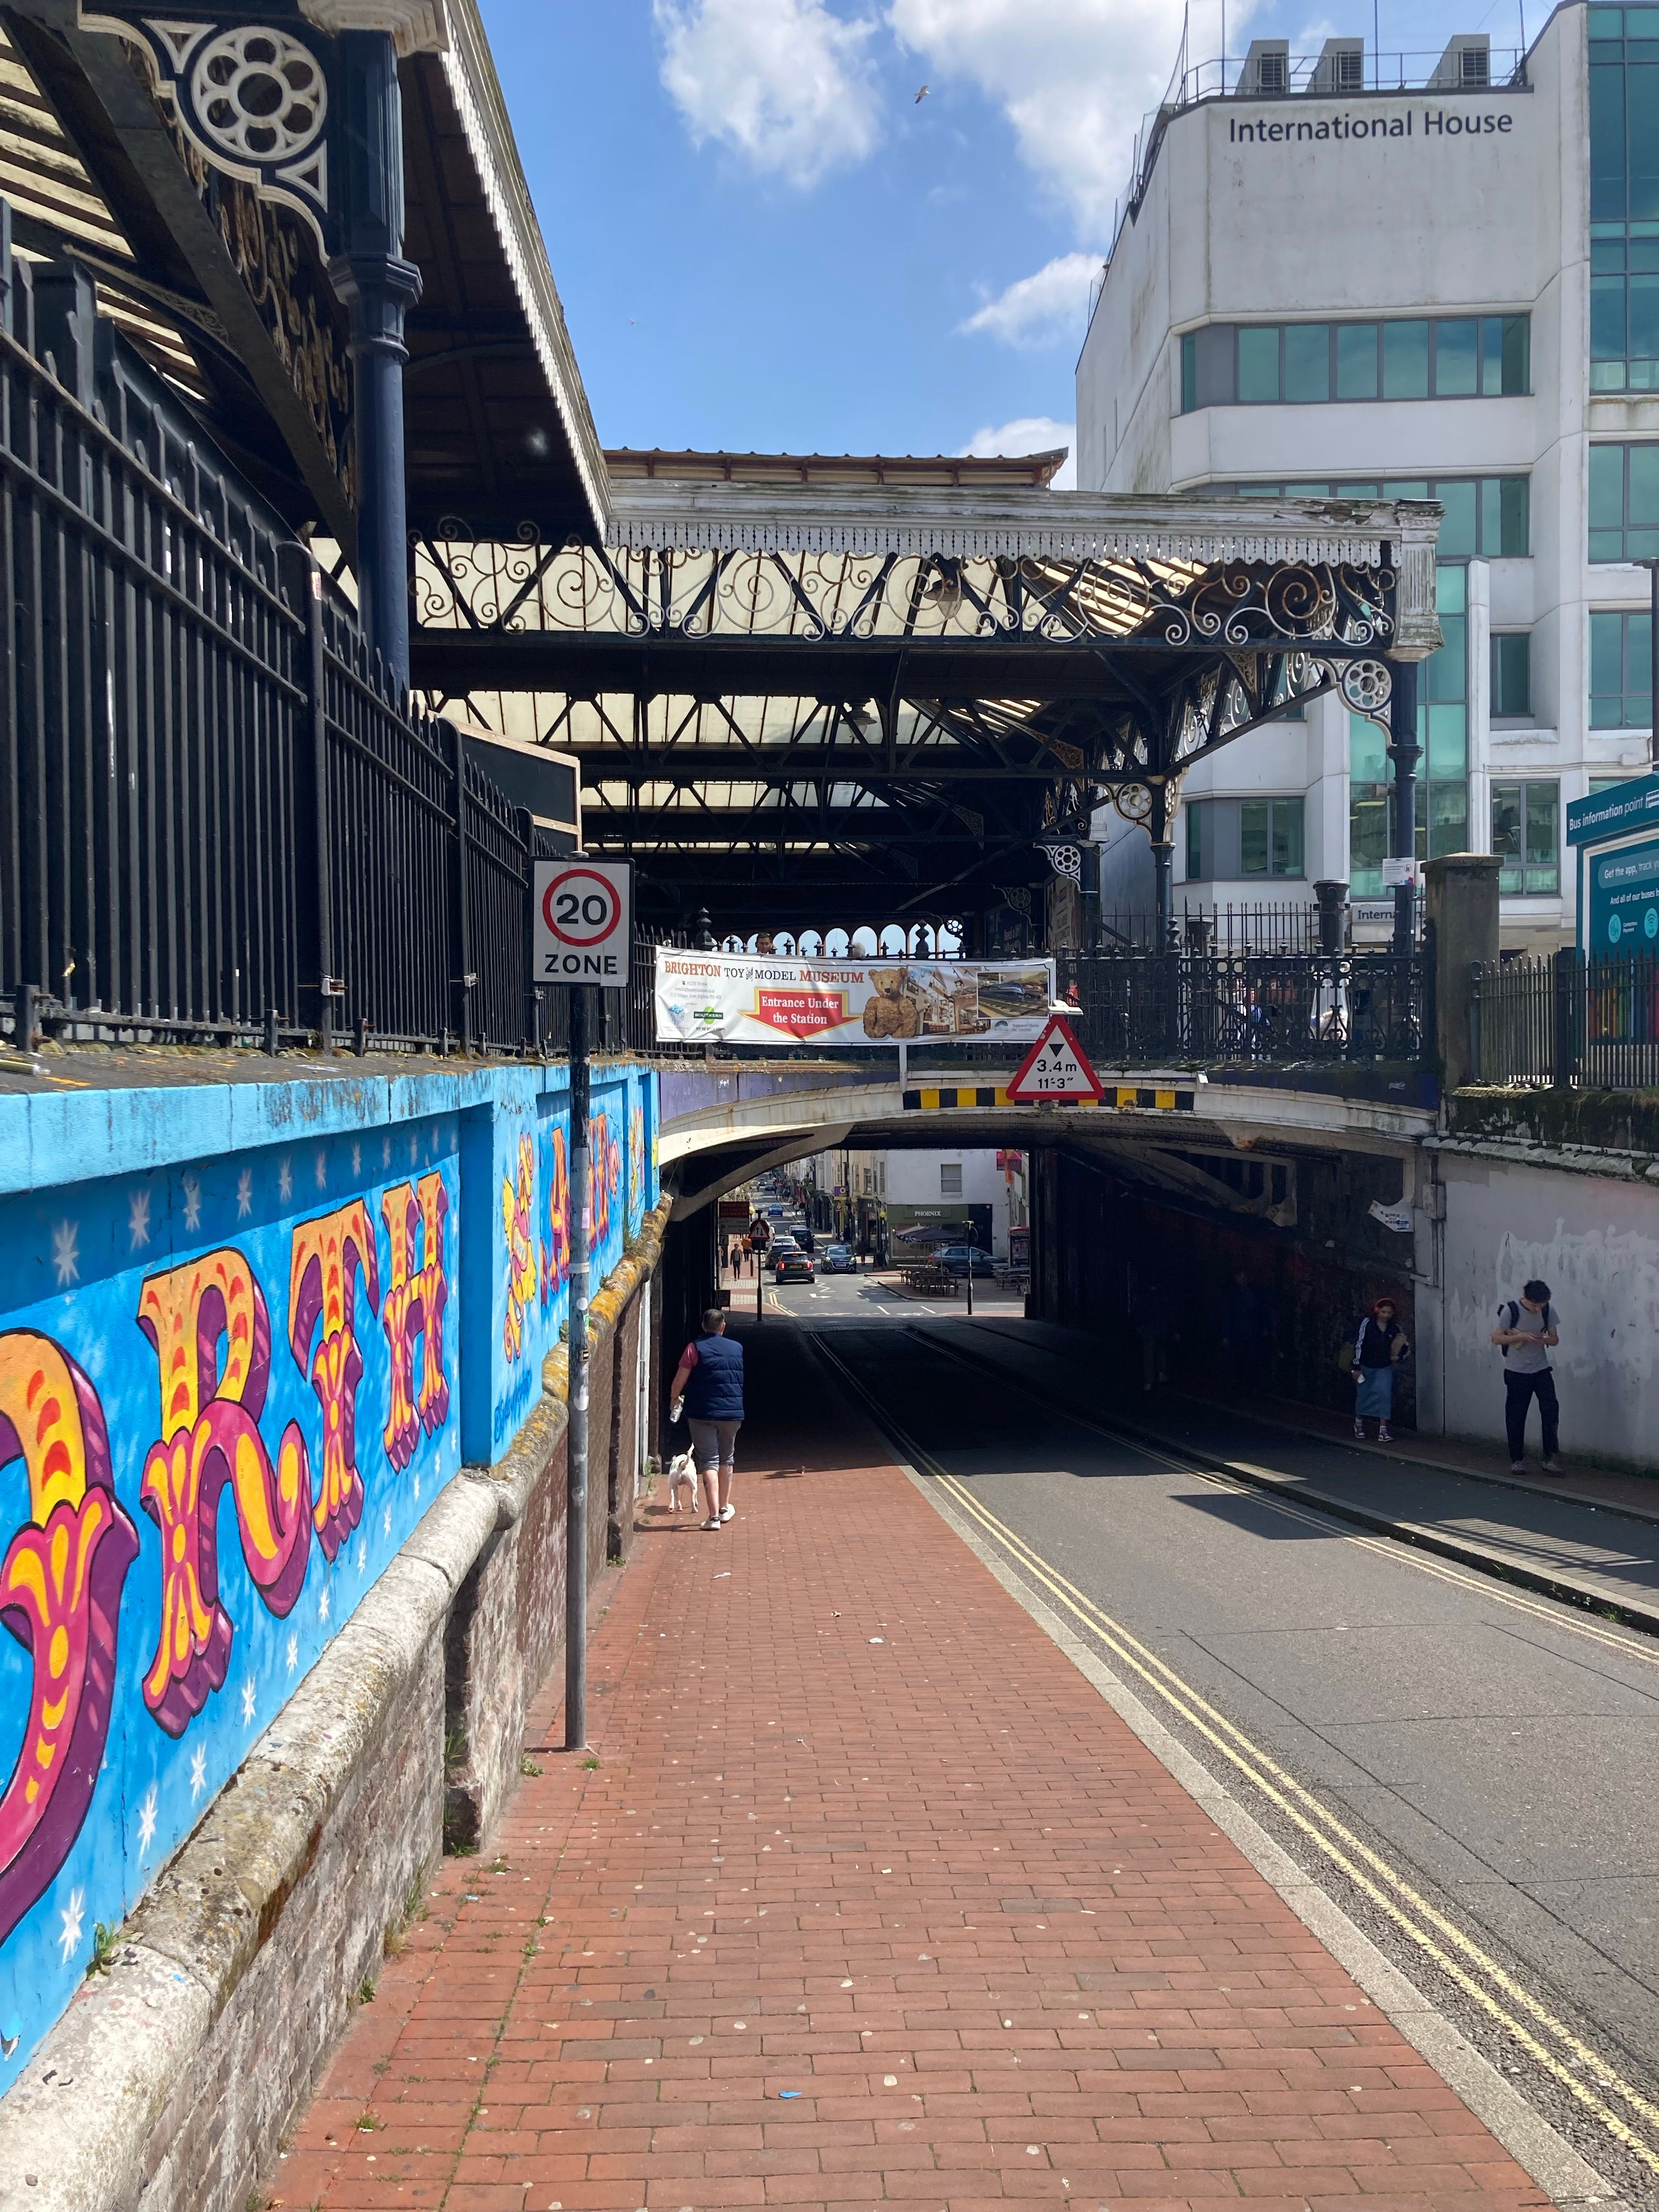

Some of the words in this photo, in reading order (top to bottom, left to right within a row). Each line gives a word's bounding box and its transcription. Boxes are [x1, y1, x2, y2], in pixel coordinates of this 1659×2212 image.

[1231, 110, 1412, 142] International
[1425, 111, 1513, 135] House
[1569, 819, 1581, 831] Bus
[1583, 804, 1623, 827] information
[1624, 796, 1644, 817] point
[1604, 868, 1615, 879] Get
[1615, 867, 1624, 877] the
[1626, 865, 1638, 877] app,
[1610, 895, 1620, 905] And
[1626, 893, 1632, 901] of
[1641, 890, 1655, 899] buses
[556, 894, 607, 926] 20
[545, 954, 617, 974] ZONE
[665, 961, 721, 977] BRIGHTON
[724, 968, 744, 978] TOY
[755, 969, 796, 980] MODEL
[799, 970, 865, 984] MUSEUM
[761, 996, 805, 1008] Entrance
[808, 998, 839, 1009] Under
[773, 1012, 788, 1023] the
[791, 1013, 827, 1024] Station
